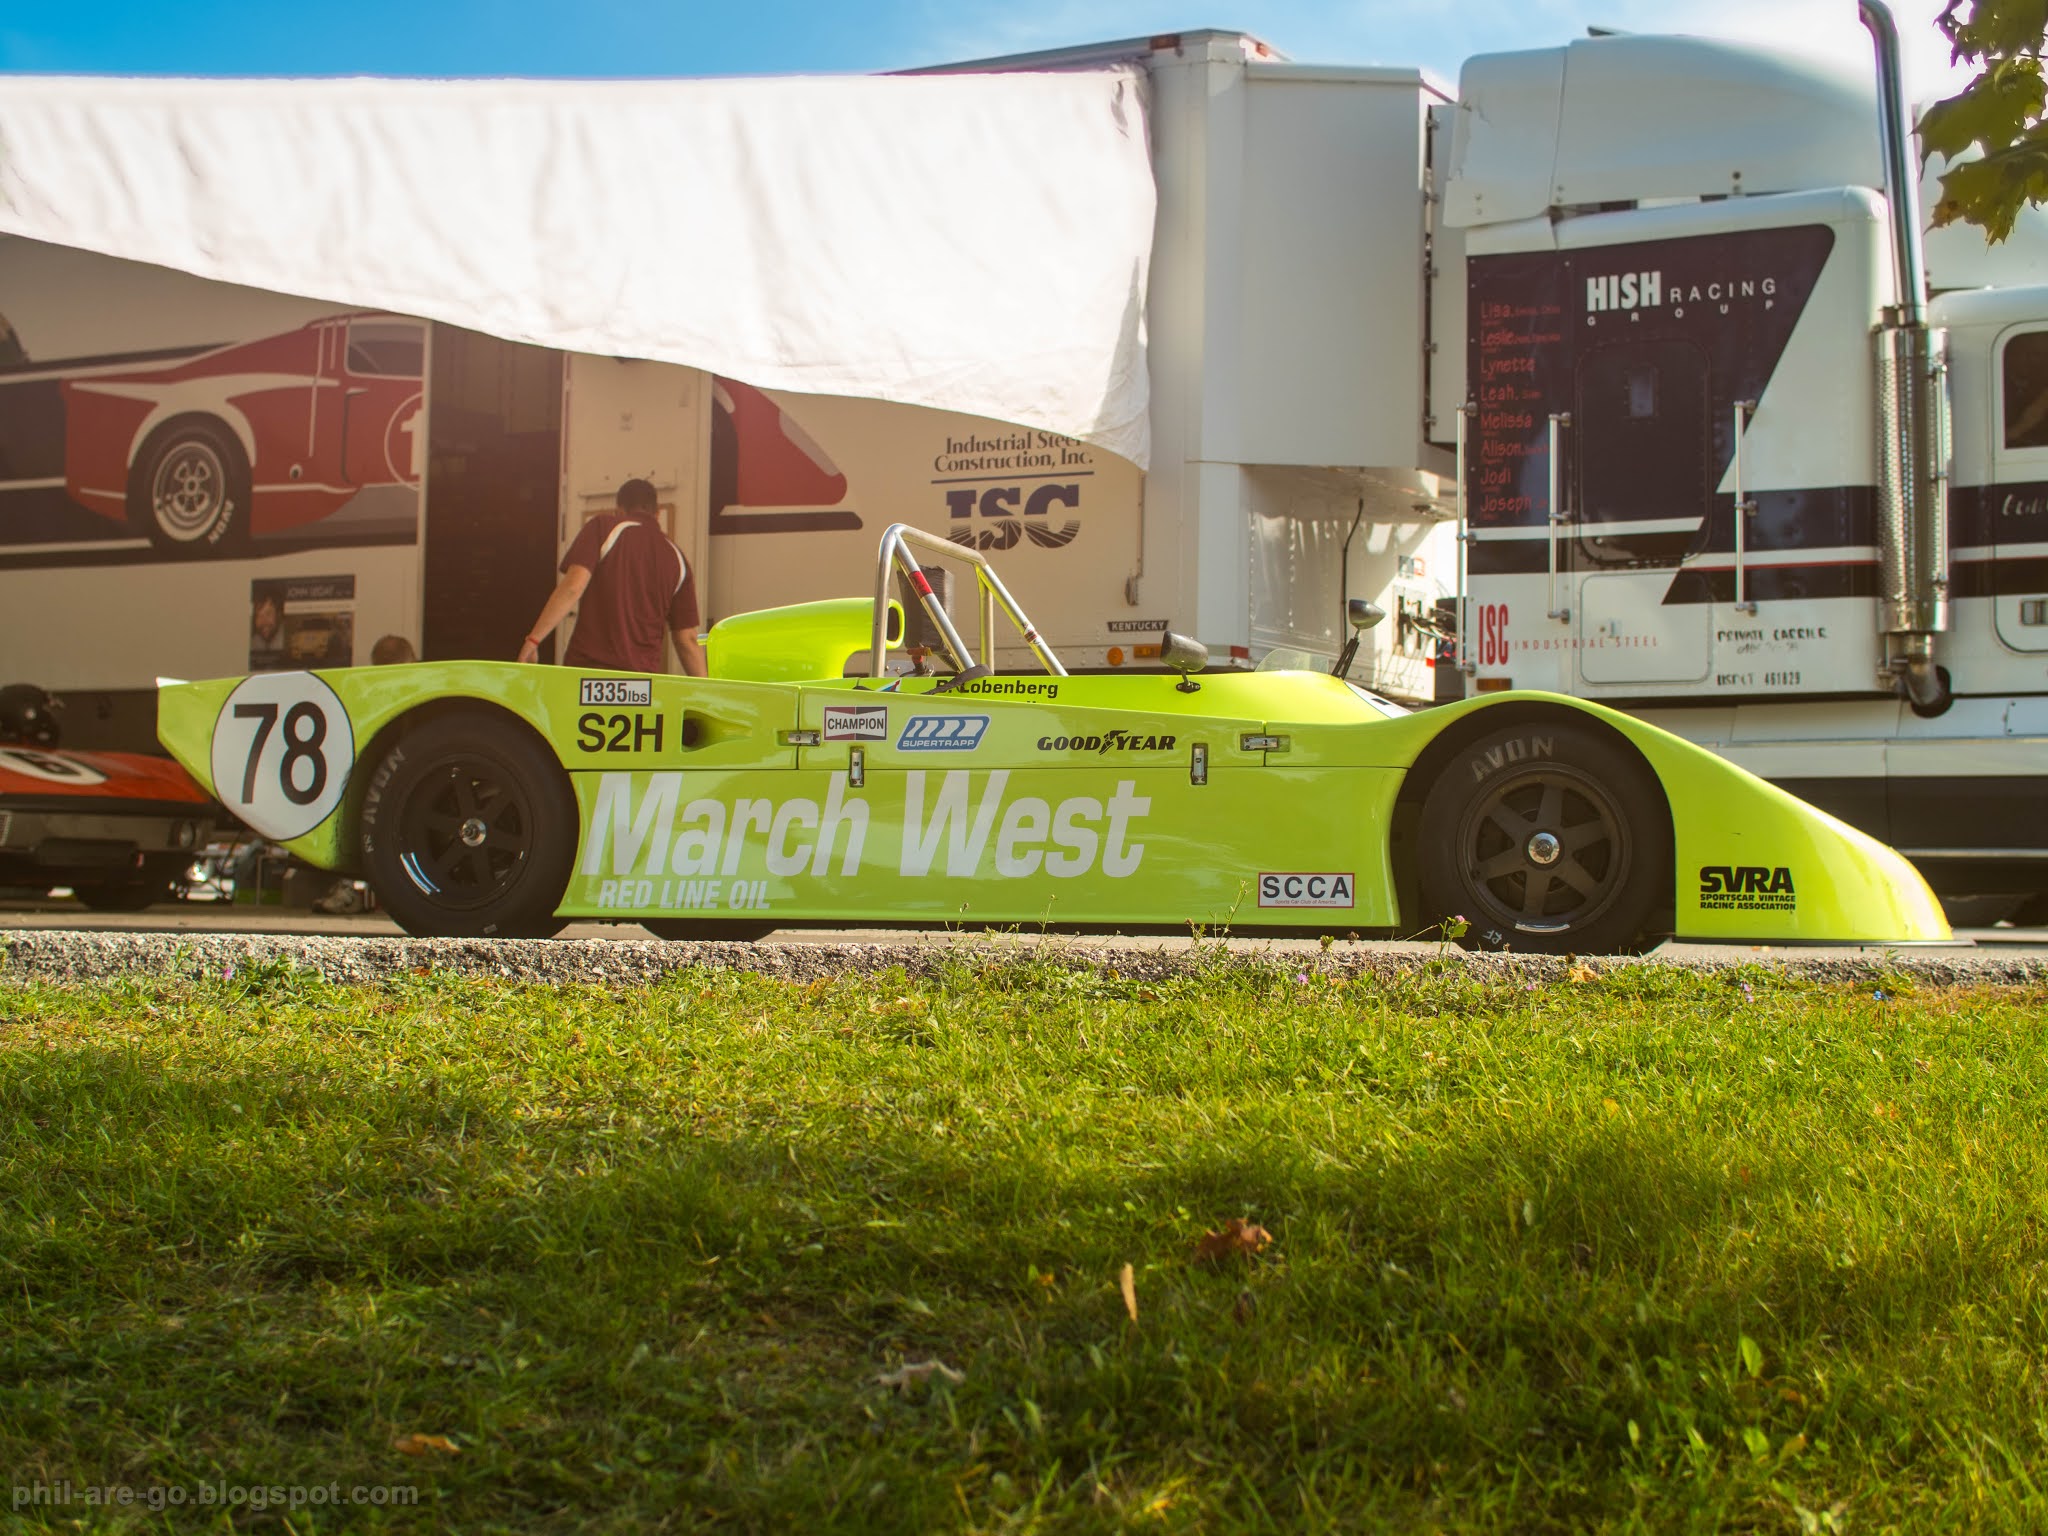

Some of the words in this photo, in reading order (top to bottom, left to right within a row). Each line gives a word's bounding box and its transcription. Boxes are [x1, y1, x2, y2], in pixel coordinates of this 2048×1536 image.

[1587, 271, 1661, 312] HISH
[1670, 278, 1776, 303] RACING
[946, 432, 1031, 454] Industrial
[935, 451, 1055, 472] Construction,
[1061, 448, 1093, 464] Inc.
[946, 484, 1081, 550] ISC
[1112, 621, 1164, 631] KENTUCKY
[1478, 604, 1508, 665] ISC
[1615, 636, 1657, 648] STEEL
[583, 682, 648, 703] 1335lbs
[576, 713, 664, 753] S2H
[827, 718, 885, 730] CHAMPION
[233, 701, 328, 805] 78
[902, 738, 975, 748] SUPERTRAPP
[580, 772, 870, 877] March
[899, 770, 1152, 879] West
[1262, 876, 1350, 898] SCCA
[1700, 866, 1795, 893] SVRA
[597, 880, 652, 909] RED
[658, 880, 721, 909] LINE
[727, 881, 771, 909] OIL
[1737, 902, 1796, 910] ASSOCIATION
